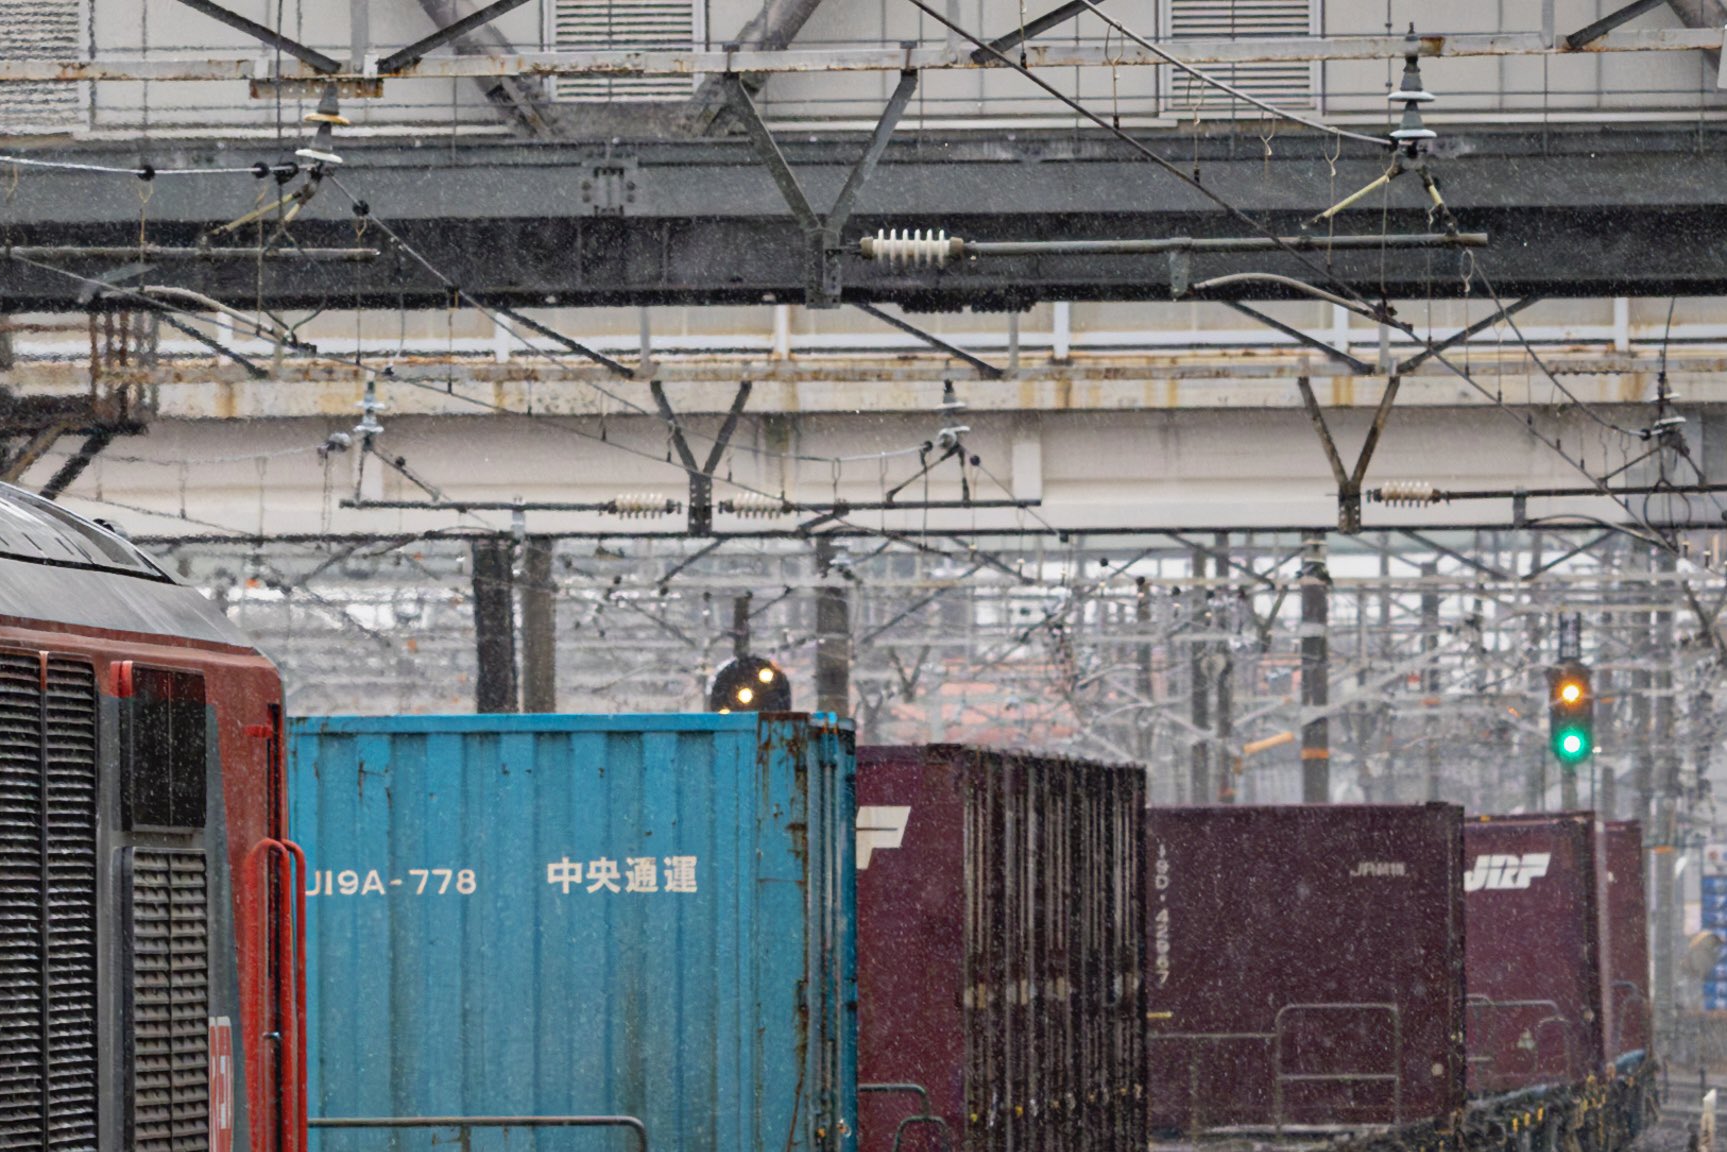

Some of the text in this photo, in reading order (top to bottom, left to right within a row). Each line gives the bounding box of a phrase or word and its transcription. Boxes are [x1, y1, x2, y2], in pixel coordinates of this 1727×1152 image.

[547, 856, 698, 894] 中央通運
[1464, 853, 1551, 892] JRF
